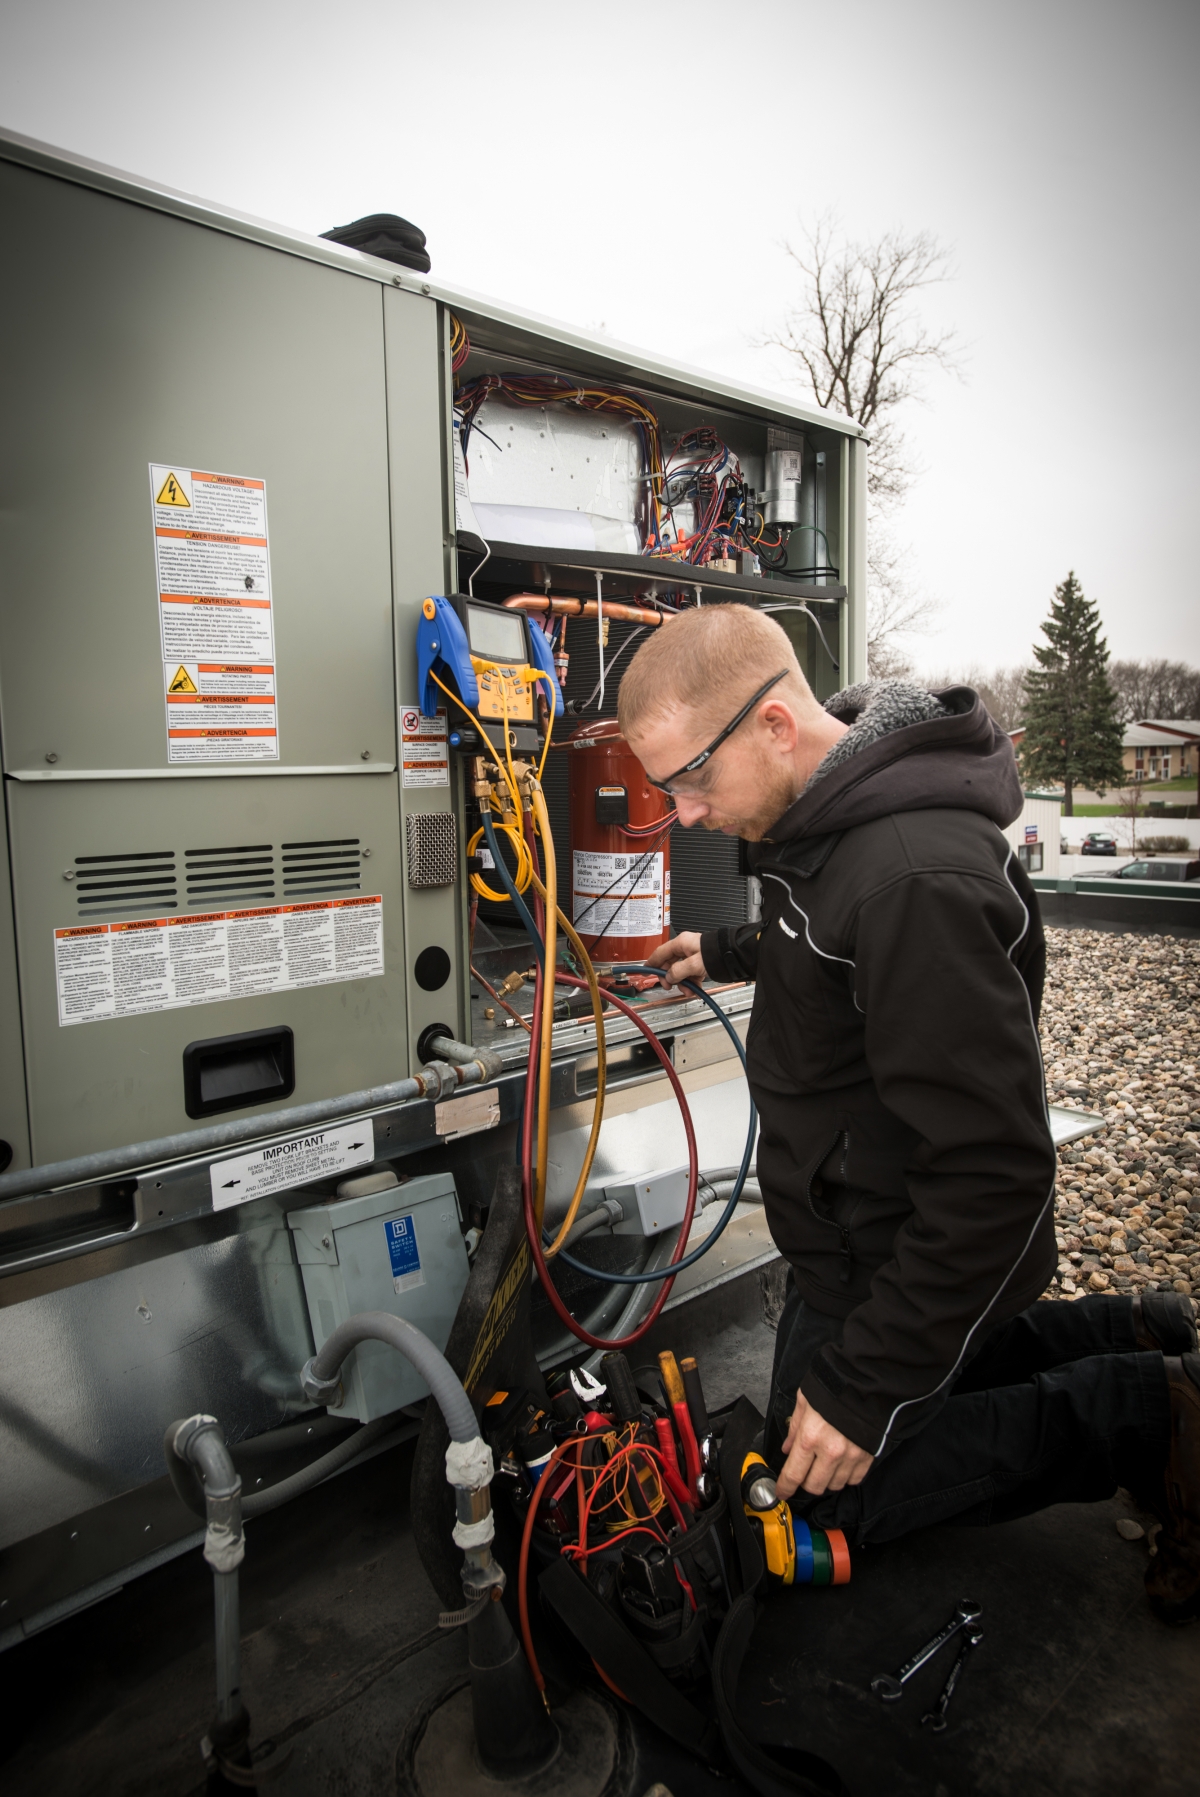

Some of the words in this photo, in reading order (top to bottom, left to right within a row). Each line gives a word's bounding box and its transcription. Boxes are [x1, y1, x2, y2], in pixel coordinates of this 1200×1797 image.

[217, 476, 244, 485] WARNING
[203, 483, 231, 491] HAZARDOUS
[192, 532, 240, 543] AVERTISSEMENT
[208, 542, 240, 550] DANGEREUSE!
[292, 903, 328, 911] ADVERTENCIA
[235, 908, 280, 917] AVERTISSEMENT
[176, 913, 224, 924] AVERTISSEMENT
[127, 921, 157, 929] WARNING
[70, 927, 102, 935] WARNING
[263, 1134, 324, 1160] IMPORTANT
[248, 1162, 268, 1171] REMOVE
[305, 1145, 328, 1154] BRACKETS
[266, 1160, 294, 1171] PROTECTION
[318, 1146, 337, 1155] SETTING
[293, 1160, 306, 1168] ROOF
[270, 1172, 284, 1181] MUST
[285, 1165, 304, 1175] REMOVE
[305, 1160, 320, 1169] SHEET
[257, 1179, 277, 1189] LUMBER
[440, 1211, 455, 1222] ON
[391, 1236, 412, 1245] SAFETY
[392, 1240, 413, 1249] SWITCH
